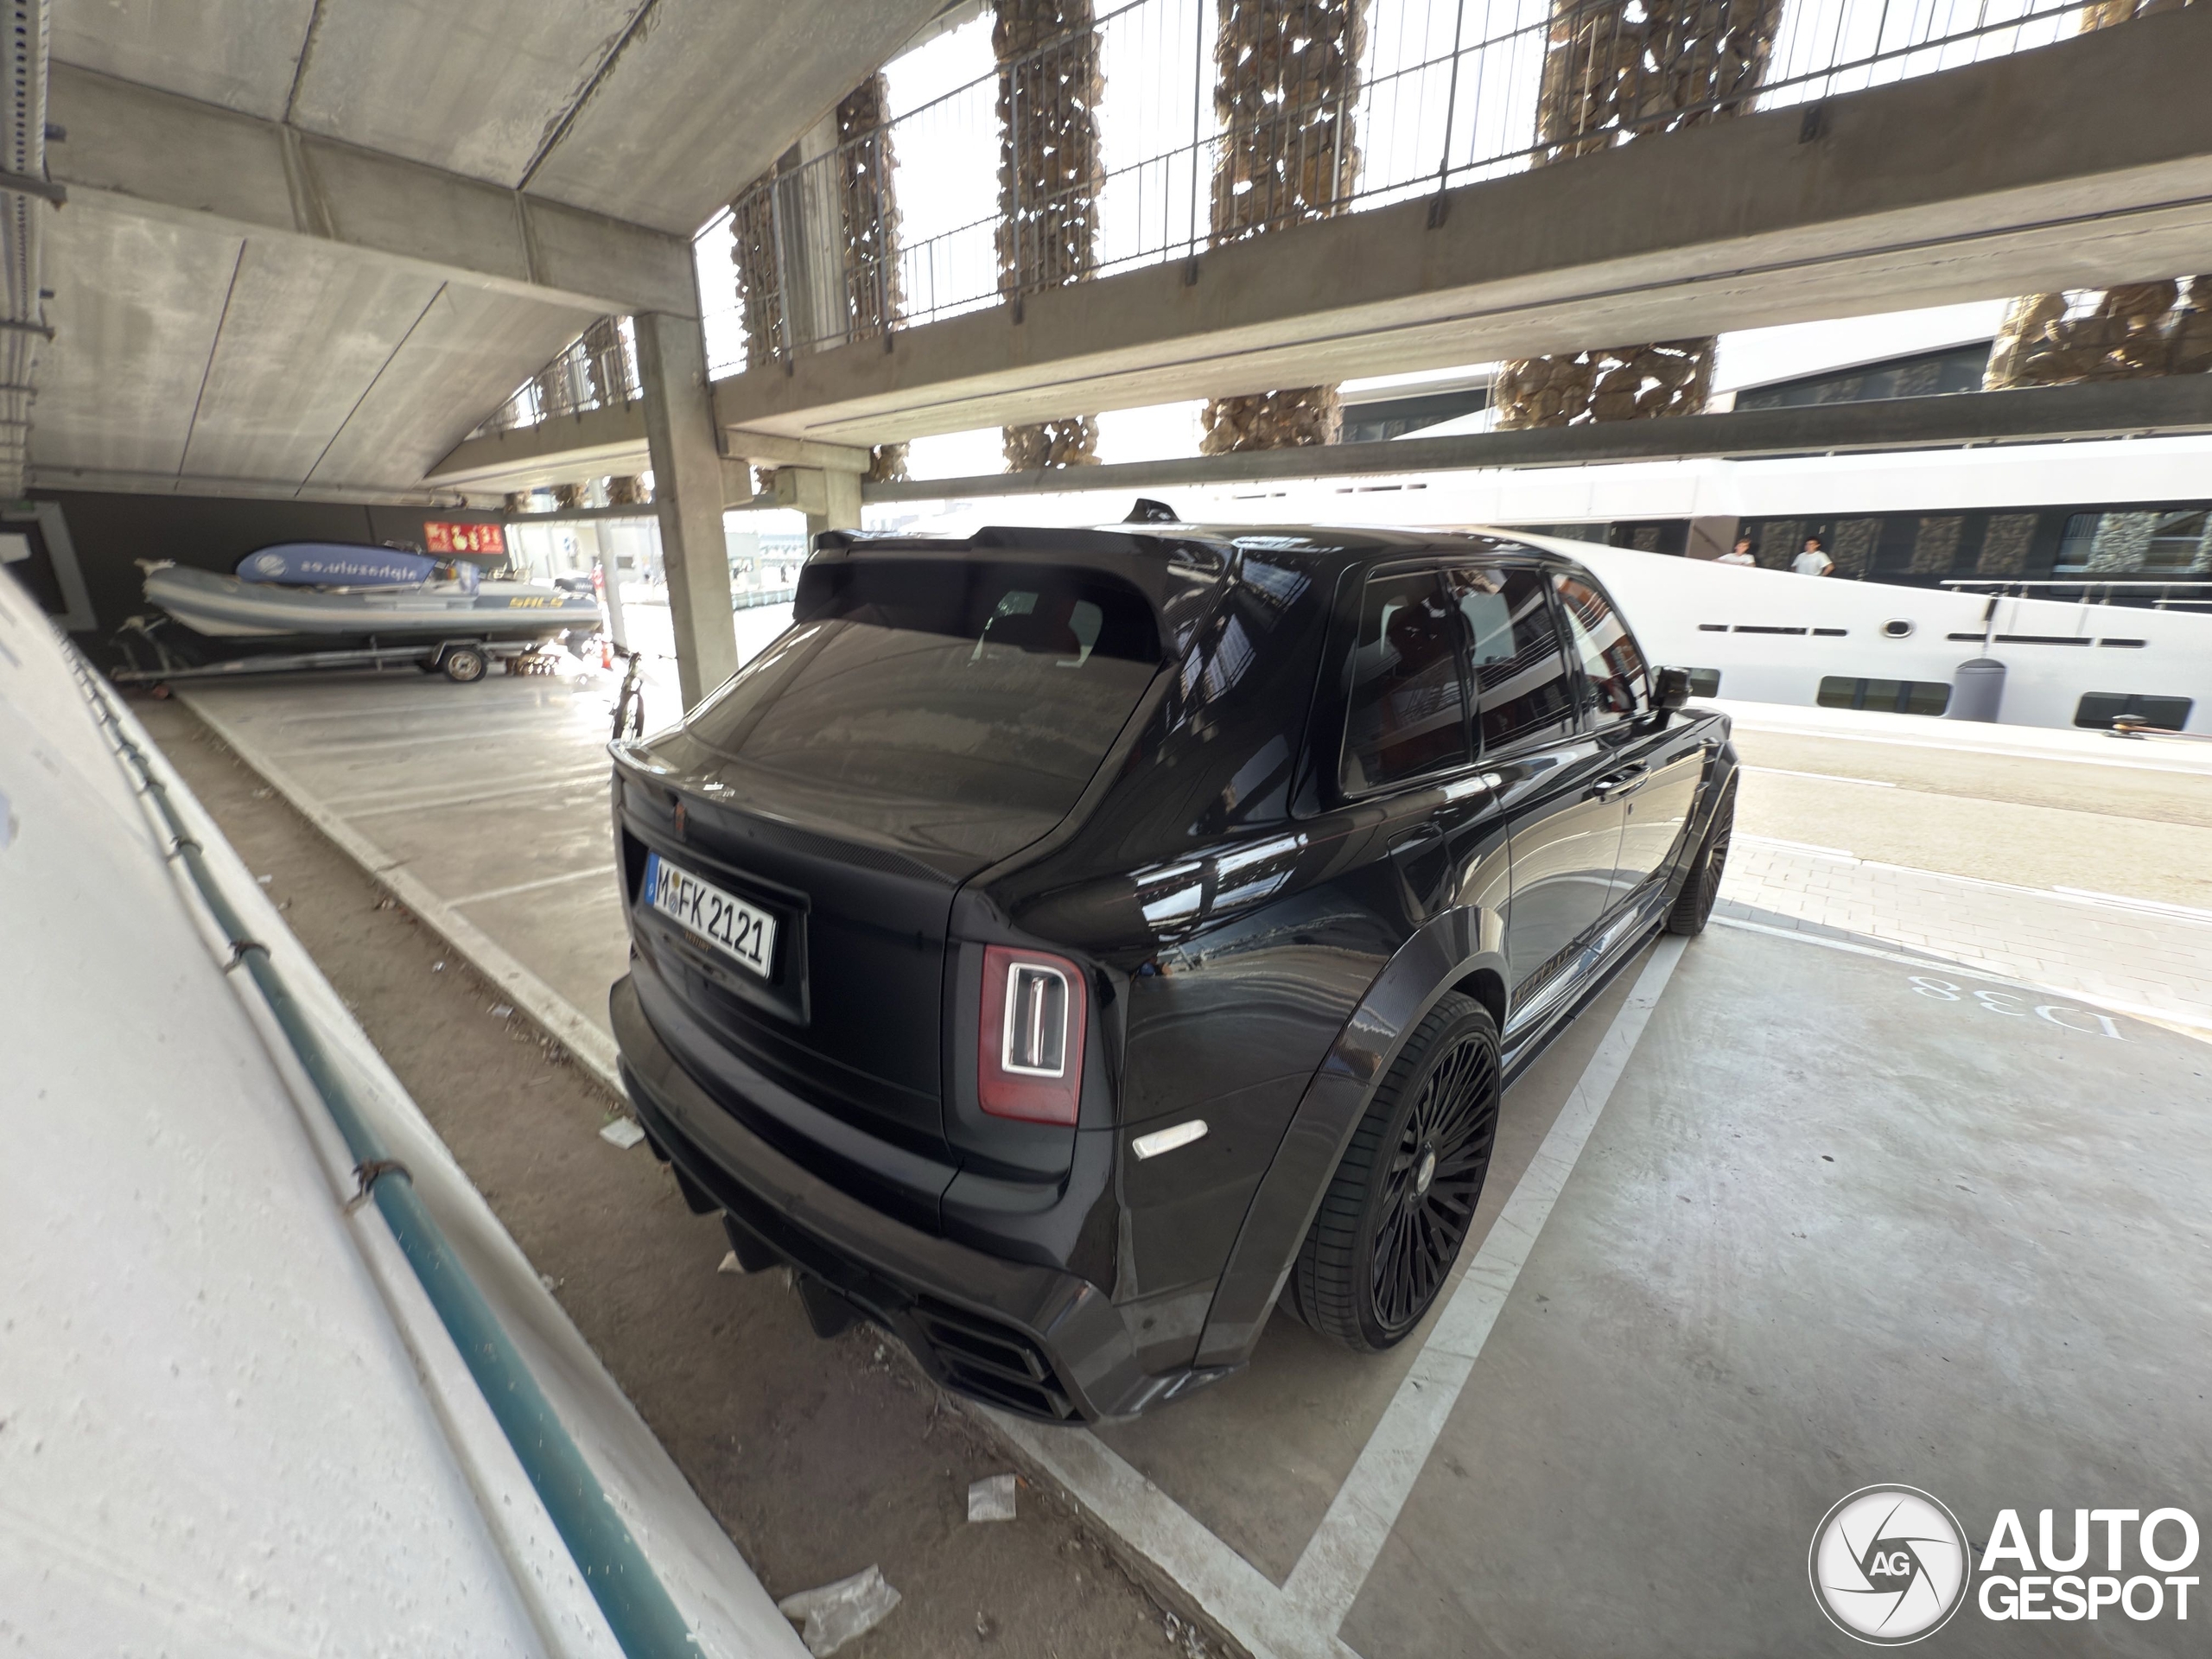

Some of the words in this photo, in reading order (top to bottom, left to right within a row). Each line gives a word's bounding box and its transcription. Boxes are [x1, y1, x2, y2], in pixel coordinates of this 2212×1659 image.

[656, 862, 670, 907] M
[677, 877, 707, 929] FK
[708, 894, 764, 965] 2121
[1907, 975, 2137, 1044] D38
